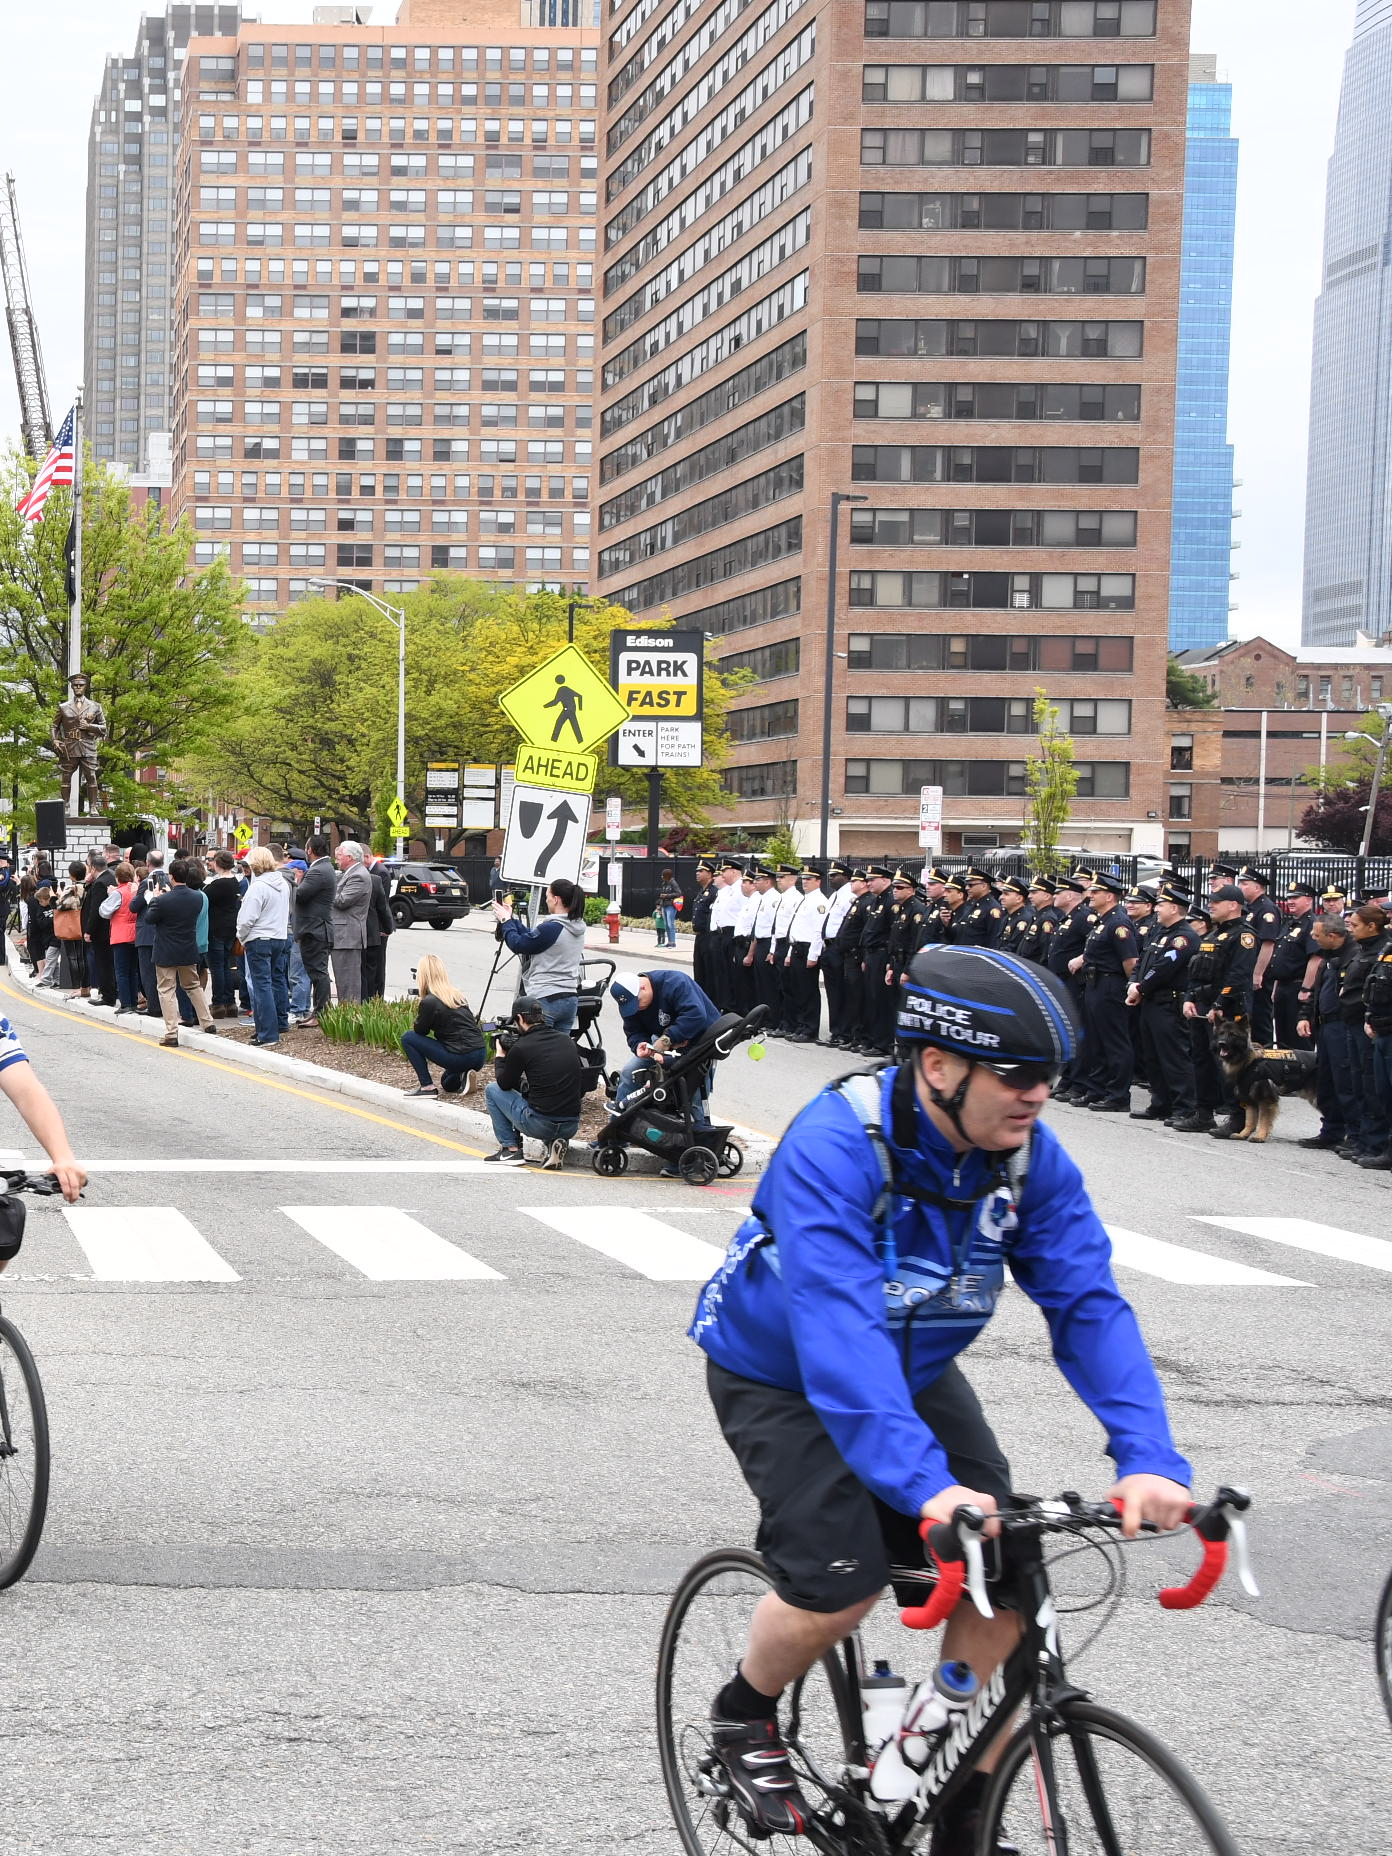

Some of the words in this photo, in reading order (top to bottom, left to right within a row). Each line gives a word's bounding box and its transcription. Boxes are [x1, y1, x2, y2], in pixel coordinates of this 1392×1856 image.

[626, 635, 674, 648] Edison
[626, 659, 689, 678] PARK
[626, 689, 688, 708] FAST
[622, 728, 654, 738] ENTER
[660, 734, 680, 742] HERE
[522, 754, 589, 782] AHEAD
[906, 995, 974, 1025] POLICE
[935, 1020, 1001, 1048] TOUR
